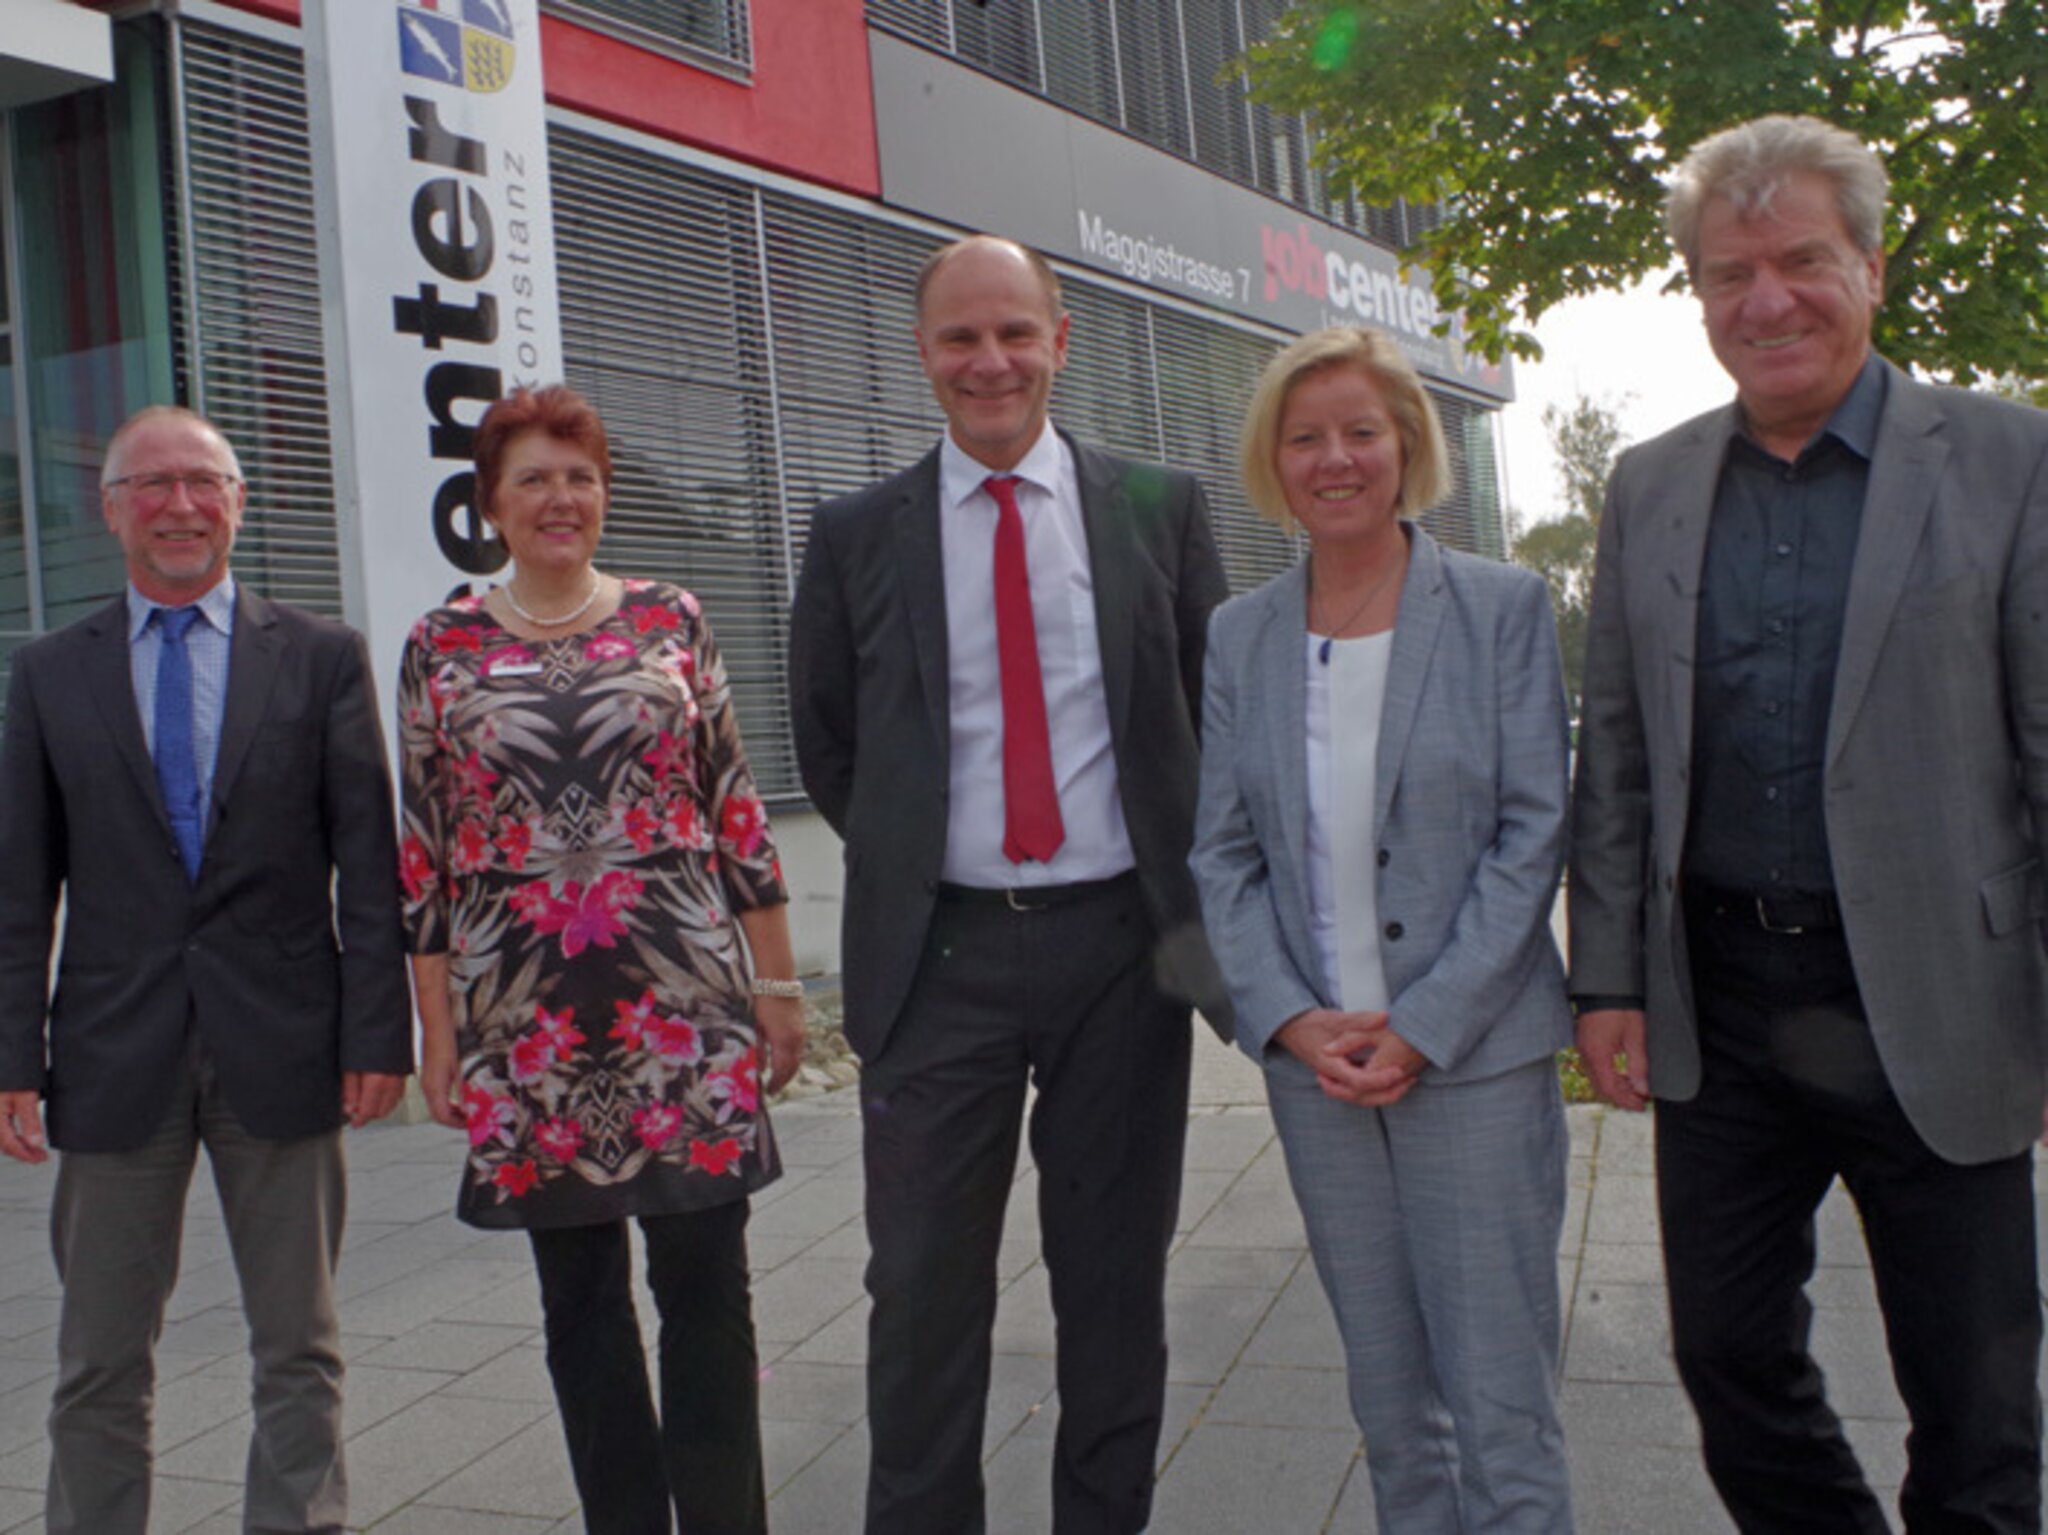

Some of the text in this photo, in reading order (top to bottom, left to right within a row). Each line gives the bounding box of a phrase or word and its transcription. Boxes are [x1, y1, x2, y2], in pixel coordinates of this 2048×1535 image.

[392, 94, 512, 606] enter
[1078, 209, 1251, 303] Maggistrasse 7
